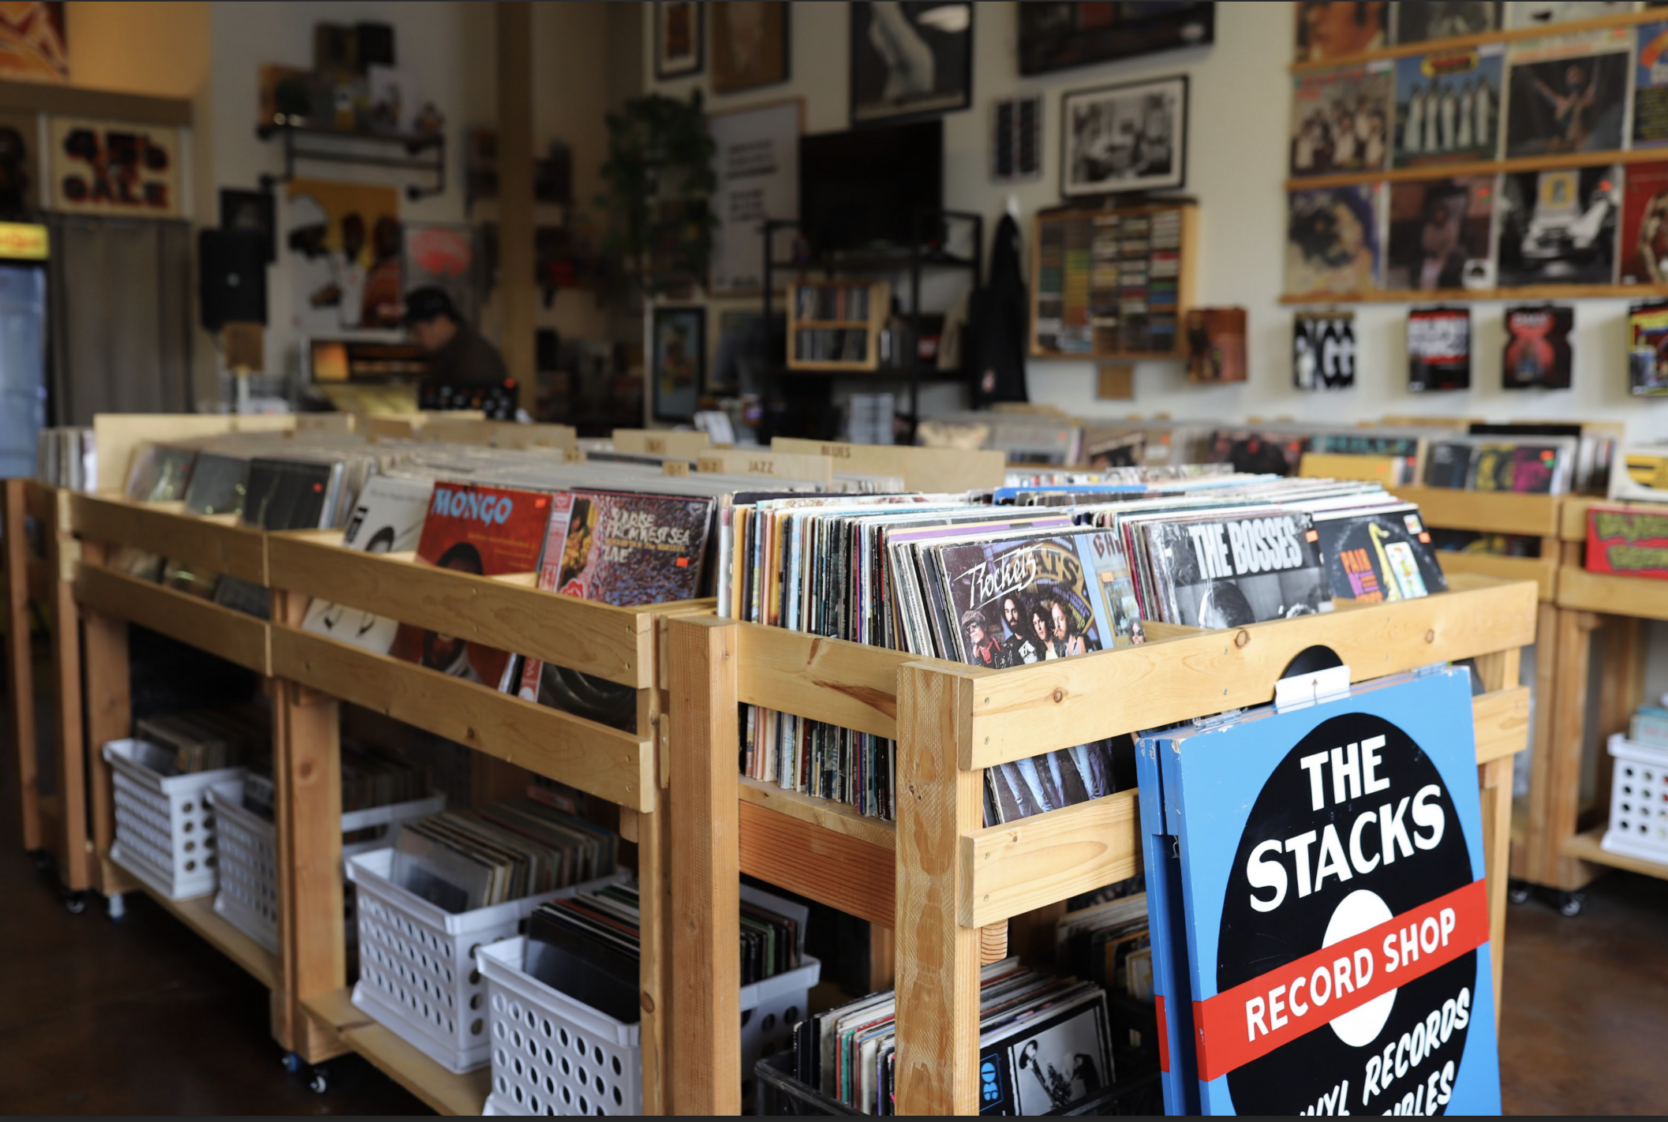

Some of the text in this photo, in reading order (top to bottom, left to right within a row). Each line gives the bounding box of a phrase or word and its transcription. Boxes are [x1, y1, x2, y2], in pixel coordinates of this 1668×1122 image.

[747, 459, 774, 474] JAZZ
[820, 444, 852, 460] BLUES
[431, 488, 514, 527] MONGO
[605, 523, 640, 541] FROM
[639, 526, 669, 544] WEST
[668, 528, 691, 546] SEA
[1188, 515, 1304, 580] THE BOSSES
[1300, 734, 1390, 812] THE
[1246, 784, 1445, 913] STACKS
[1245, 907, 1456, 1042] RECORD SHOP
[1362, 987, 1470, 1106] RECORDS
